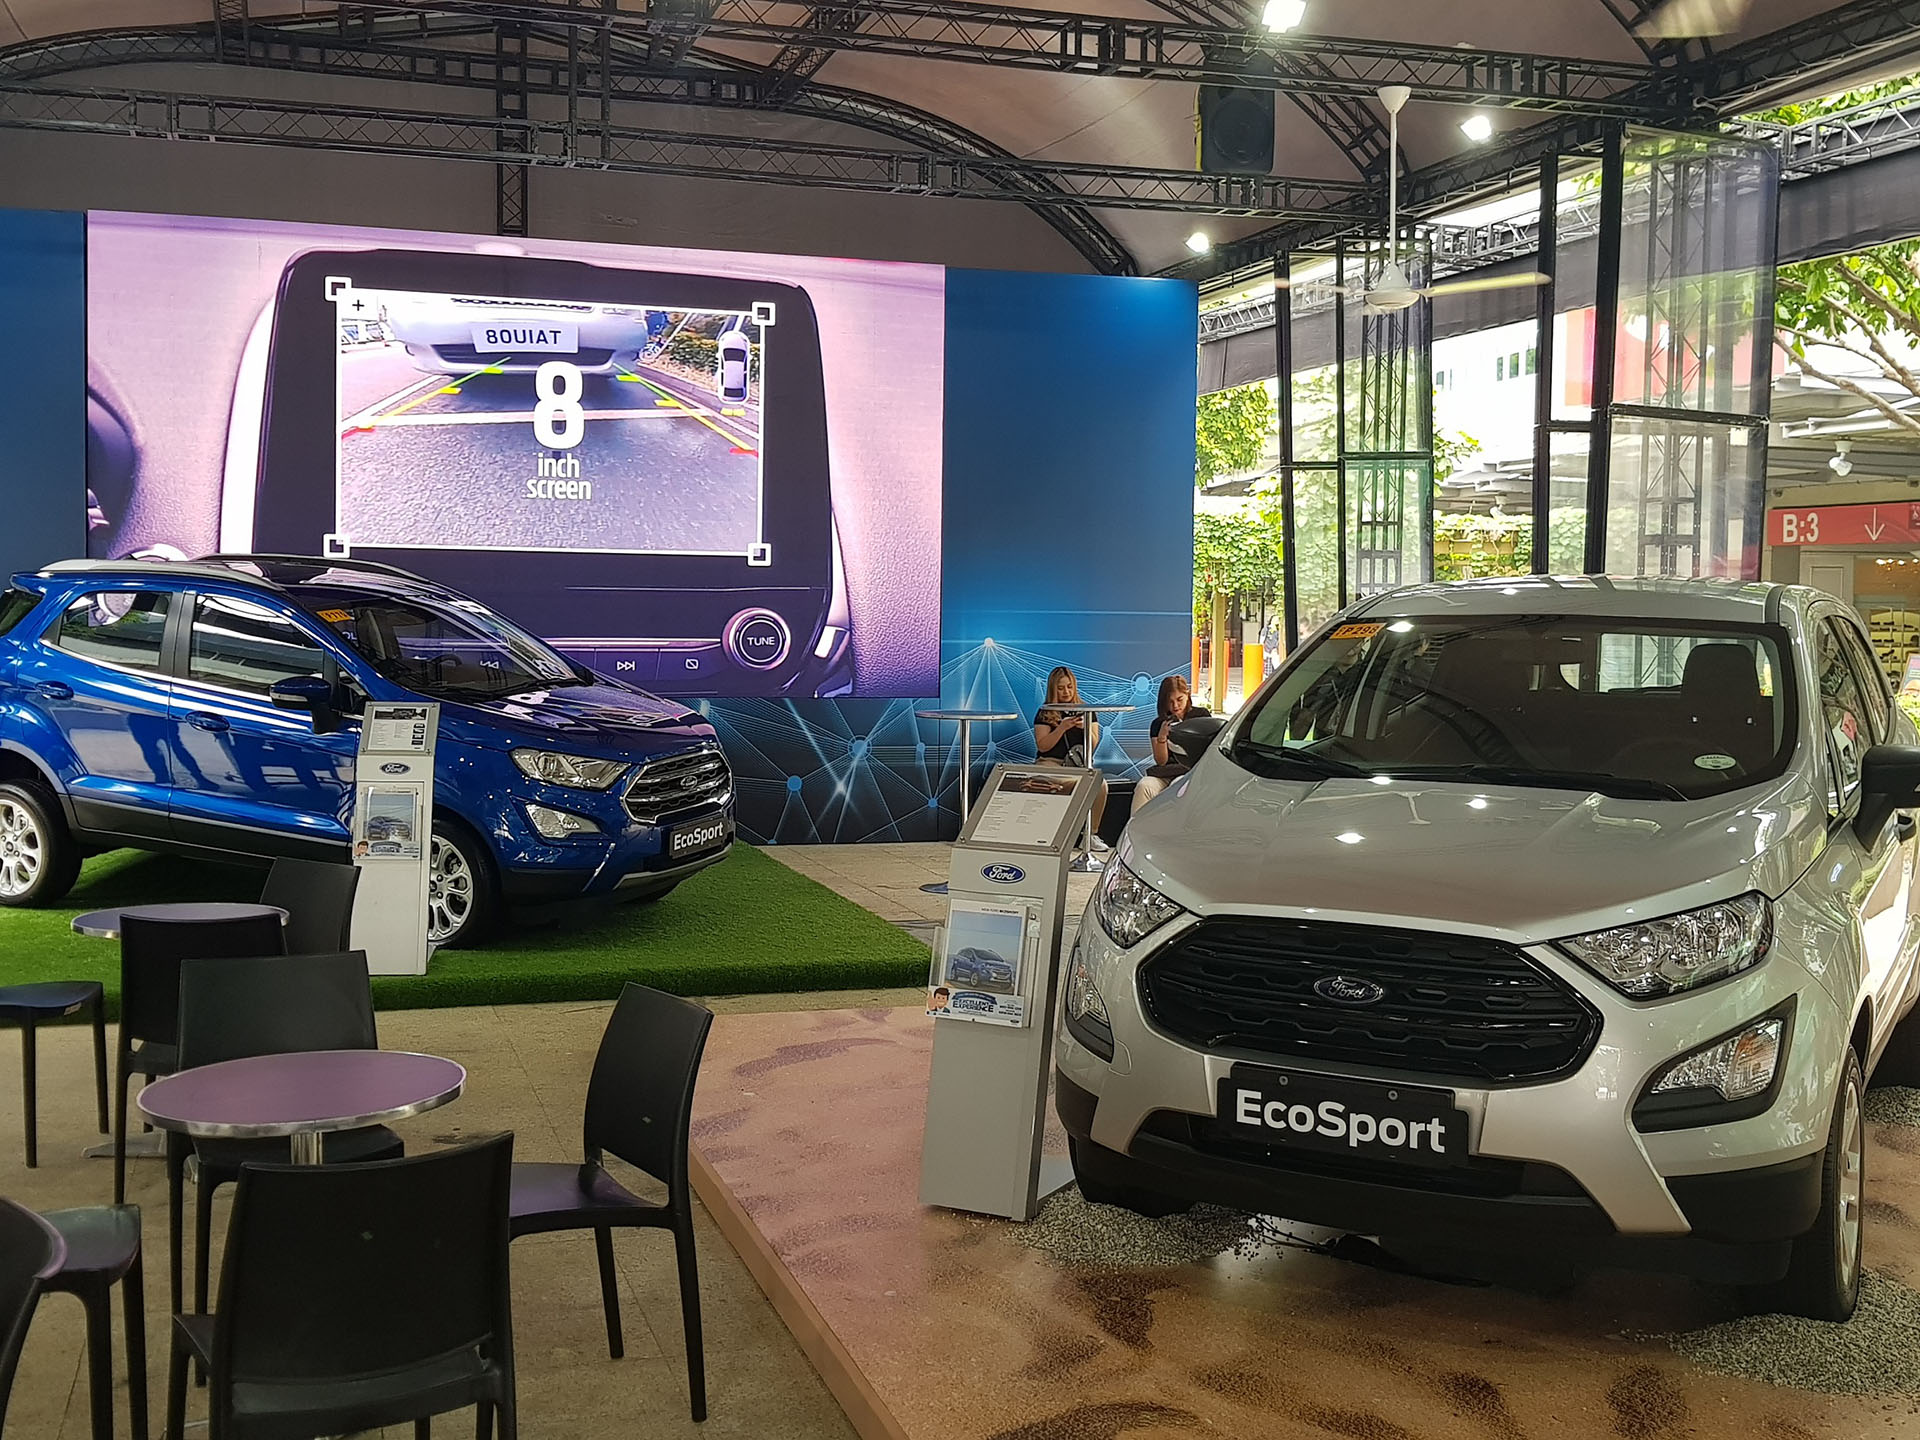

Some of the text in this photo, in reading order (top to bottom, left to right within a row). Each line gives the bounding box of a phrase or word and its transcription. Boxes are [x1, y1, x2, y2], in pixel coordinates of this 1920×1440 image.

[533, 360, 585, 450] 8
[537, 452, 580, 478] inch
[526, 478, 592, 500] screen
[746, 636, 776, 647] TUNE
[673, 821, 724, 851] EcoSport
[989, 865, 1016, 880] Ford
[1329, 979, 1366, 998] Ford
[1236, 1088, 1446, 1153] EcoSport
